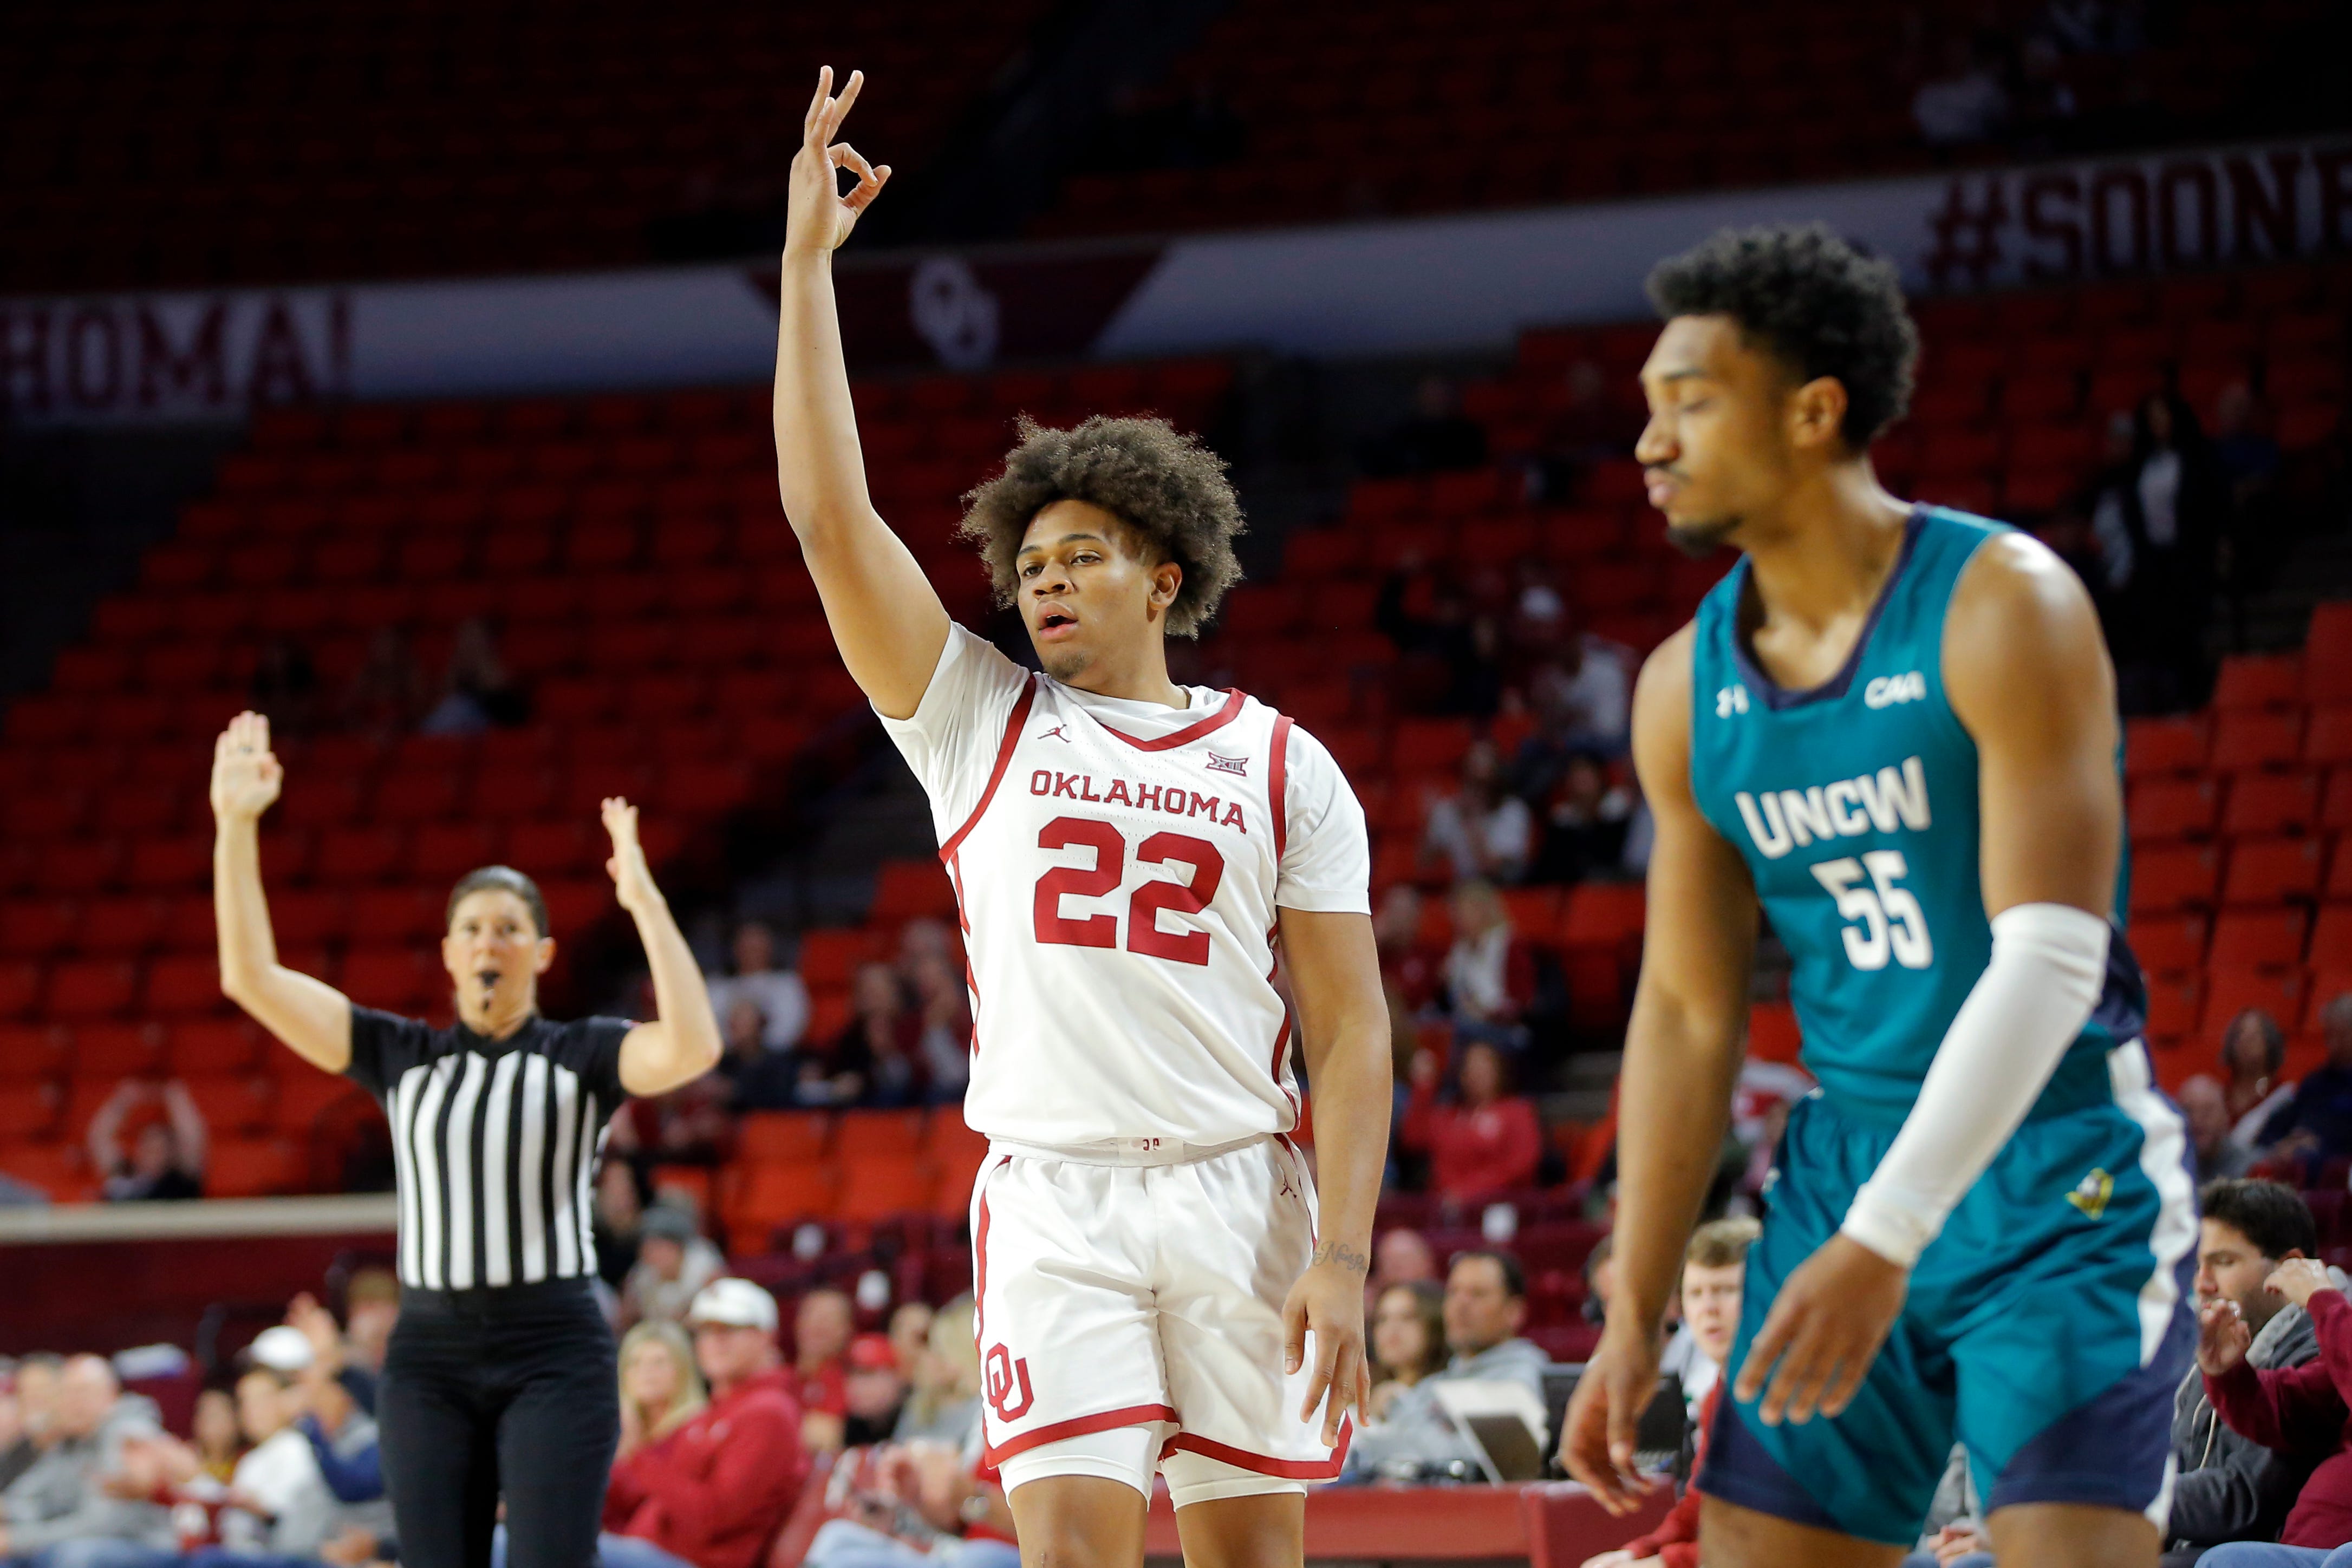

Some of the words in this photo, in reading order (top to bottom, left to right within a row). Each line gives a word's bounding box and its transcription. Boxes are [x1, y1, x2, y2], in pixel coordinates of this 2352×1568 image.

[1864, 670, 1927, 710] CAA
[1030, 770, 1247, 834] OKLAHOMA
[1734, 755, 1932, 860] UNCW
[1033, 816, 1225, 966] 22
[1809, 850, 1934, 971] 55
[985, 1342, 1034, 1423] OU
